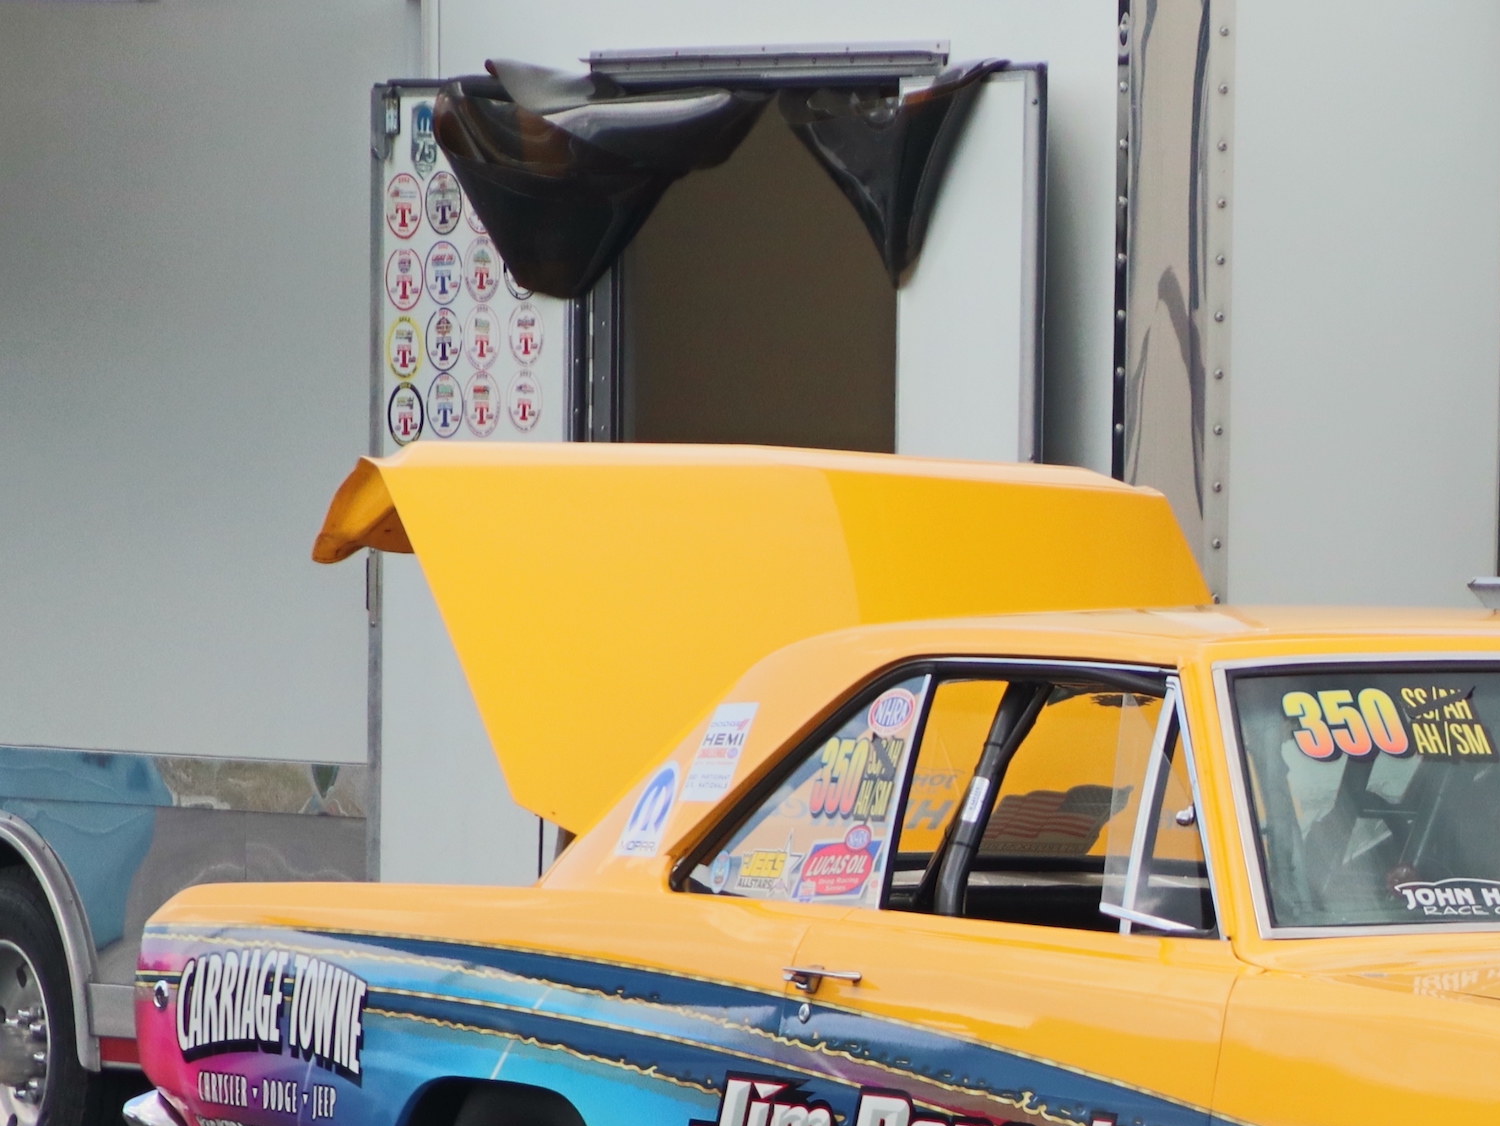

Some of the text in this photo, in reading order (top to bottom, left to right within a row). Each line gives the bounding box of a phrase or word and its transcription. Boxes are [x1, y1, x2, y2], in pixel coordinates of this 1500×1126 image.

[875, 697, 909, 728] NHRA
[1282, 688, 1409, 759] 350
[702, 733, 745, 746] HEMI
[1412, 721, 1492, 756] AH/SM
[809, 737, 869, 816] 350
[806, 853, 869, 877] LUCAS OIL
[1402, 887, 1475, 910] JOHN
[1423, 905, 1488, 916] RACE
[176, 948, 368, 1076] CARRIAGE TOWNE
[198, 1070, 337, 1120] CHRYSLER DODGE JEEP
